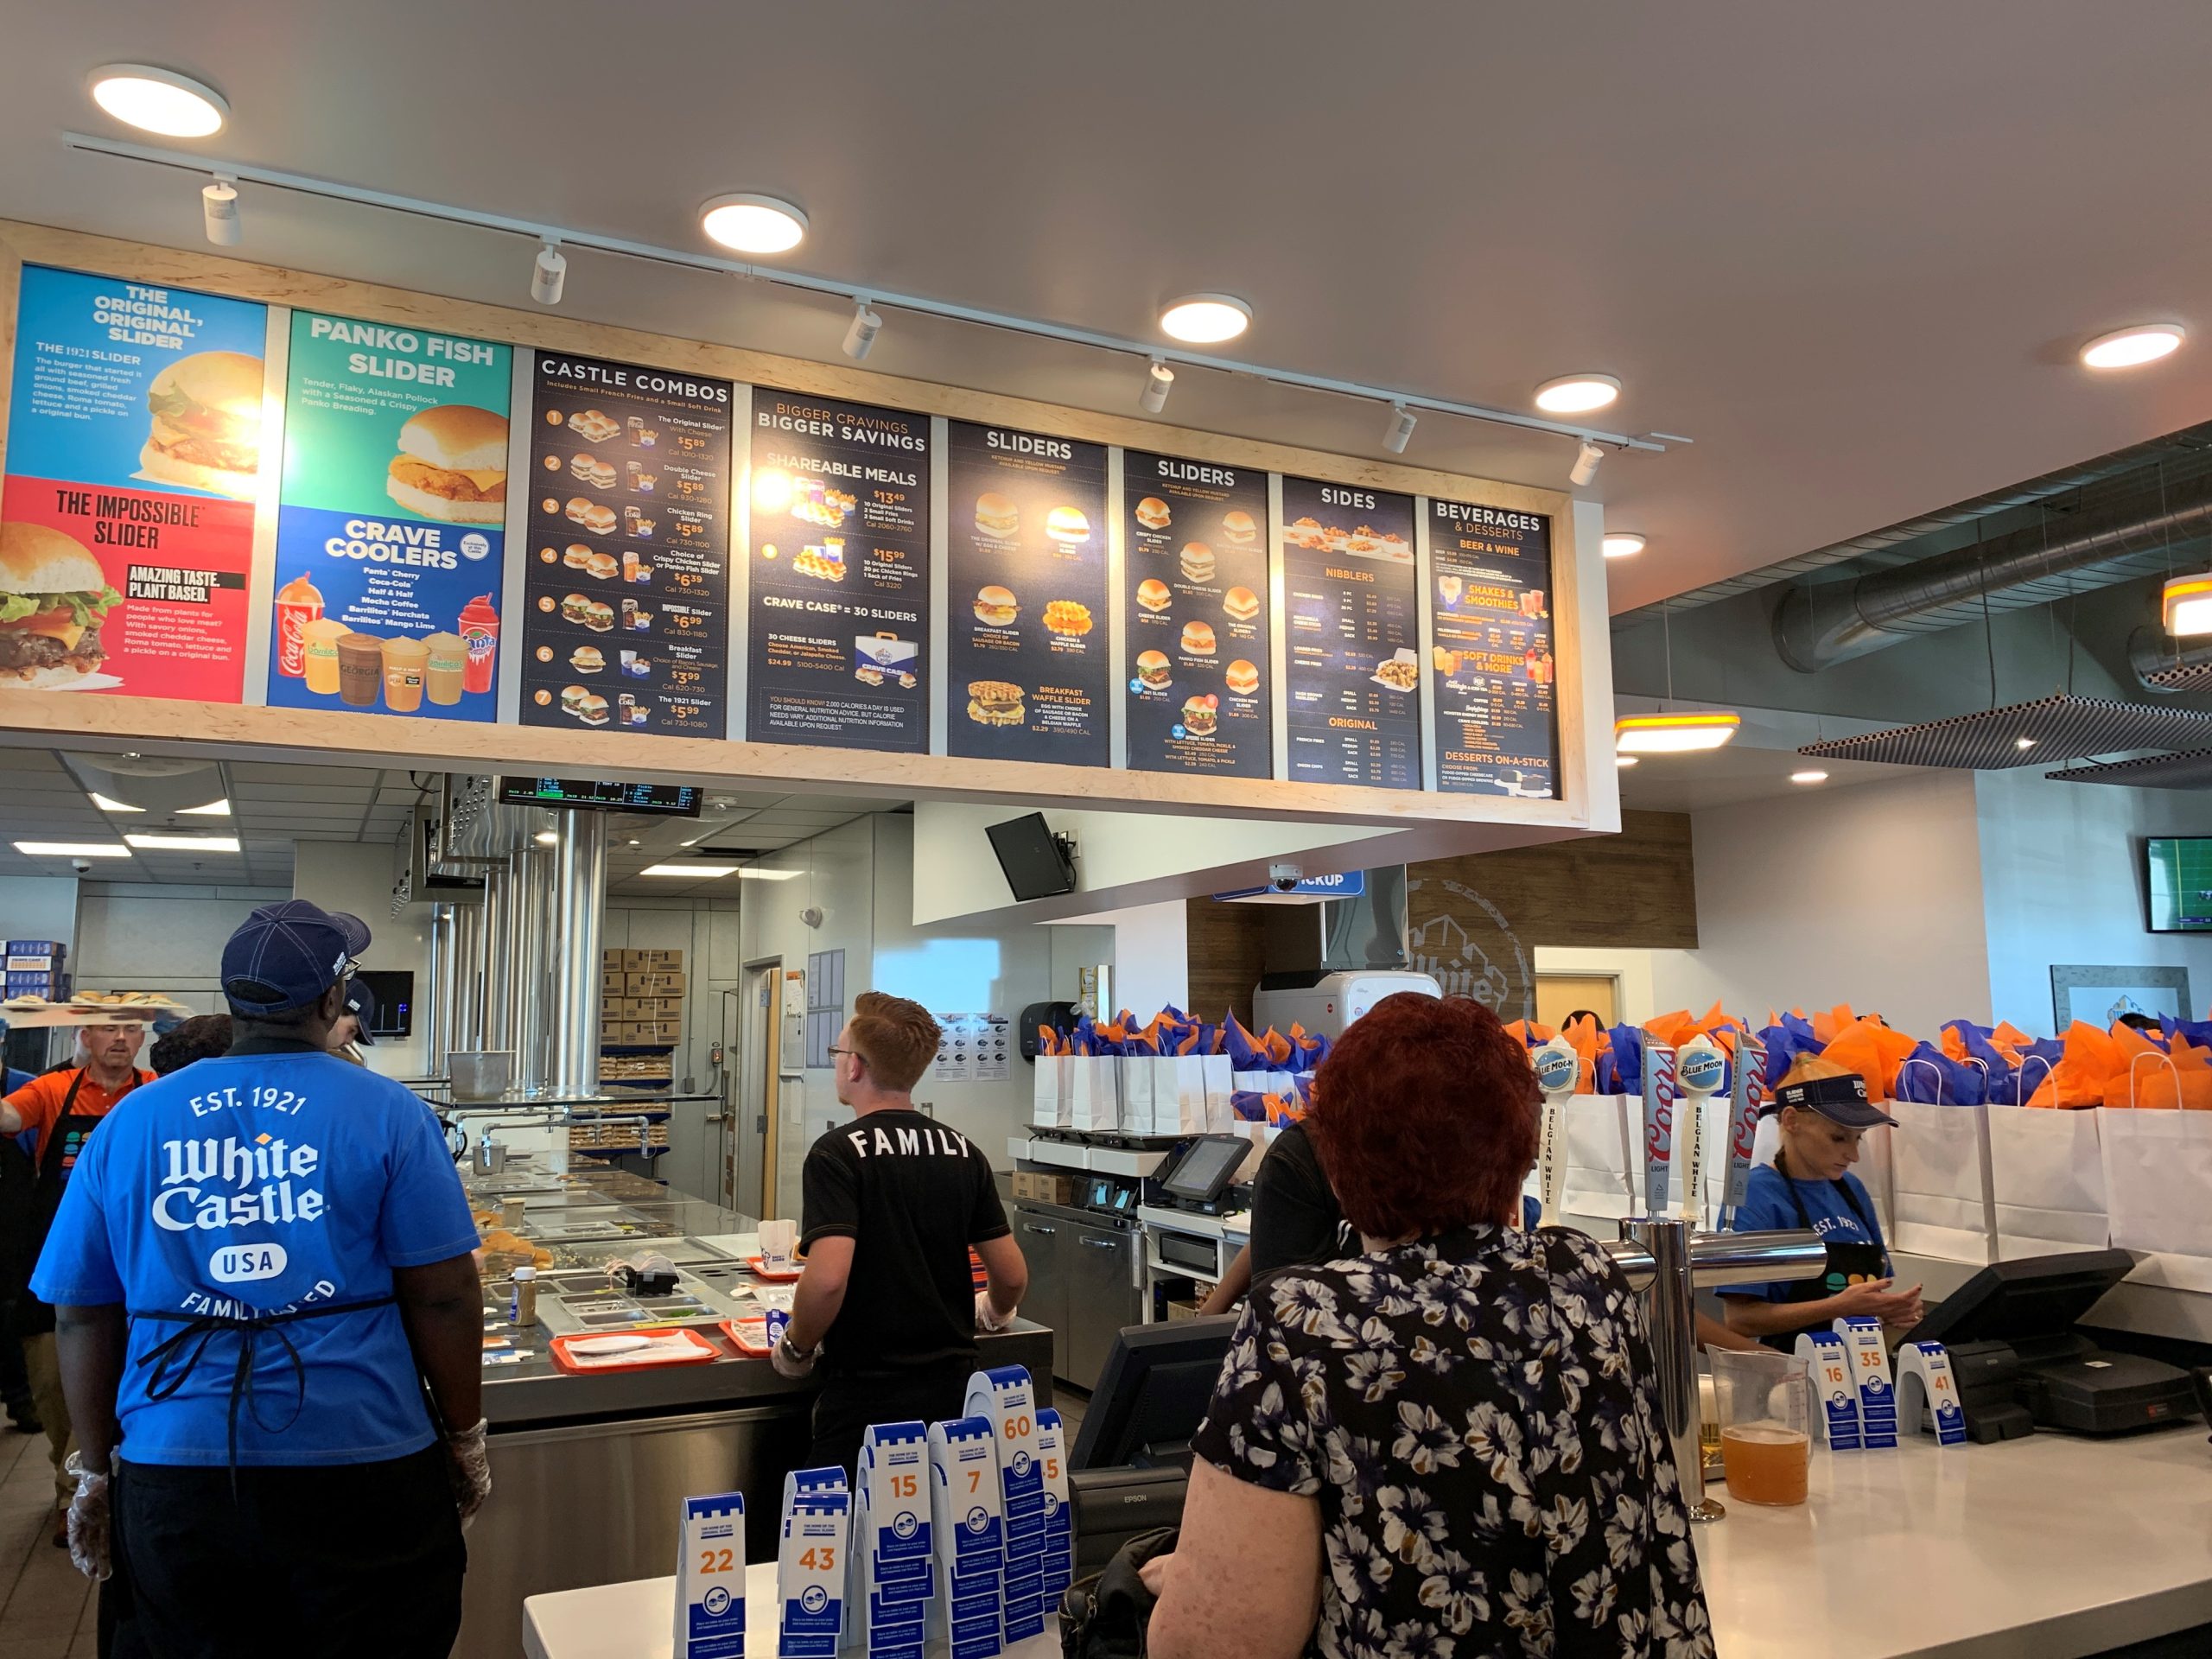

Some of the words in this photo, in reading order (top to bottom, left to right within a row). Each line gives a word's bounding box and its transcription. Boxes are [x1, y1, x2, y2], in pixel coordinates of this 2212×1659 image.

[126, 285, 168, 303] THE
[95, 296, 203, 327] ORIGINAL,
[93, 311, 194, 337] ORIGINAL
[109, 327, 183, 350] SLIDER
[311, 318, 418, 353] PANKO
[427, 337, 493, 366] FISH
[36, 342, 64, 354] THE
[66, 346, 90, 358] 1921
[92, 350, 141, 365] SLIDER
[54, 359, 83, 370] burger
[104, 365, 134, 376] started
[348, 353, 455, 387] SLIDER
[302, 378, 337, 390] Tender,
[339, 382, 365, 395] Flaky,
[368, 387, 403, 399] Alaskan
[405, 392, 438, 404] Pollock
[542, 359, 627, 386] CASTLE
[635, 375, 728, 403] COMBOS
[302, 387, 322, 397] with
[334, 392, 378, 405] Seasoned
[380, 397, 385, 406] &
[389, 400, 417, 411] Crispy
[547, 380, 576, 390] Includes
[579, 385, 599, 394] Small
[601, 389, 626, 398] French
[667, 399, 686, 408] Small
[302, 397, 330, 408] Panko
[334, 402, 377, 416] Breading.
[673, 417, 700, 429] Original
[777, 404, 830, 421] BIGGER
[836, 414, 908, 434] CRAVINGS
[759, 413, 834, 437] BIGGER
[842, 427, 925, 451] SAVINGS
[987, 431, 1072, 460] SLIDERS
[766, 453, 861, 479] SHAREABLE
[866, 467, 917, 486] MEALS
[1158, 461, 1235, 486] SLIDERS
[57, 490, 92, 515] THE
[96, 494, 200, 527] IMPOSSIBLE
[1321, 488, 1376, 509] SIDES
[1436, 502, 1540, 531] BEVERAGES
[95, 521, 159, 550] SLIDER
[346, 520, 441, 548] CRAVE
[1455, 522, 1462, 531] &
[1466, 523, 1522, 540] DESSERTS
[325, 537, 458, 569] COOLERS
[1459, 539, 1484, 551] BEER
[1496, 545, 1520, 556] WINE
[130, 566, 181, 584] AMAZING
[183, 570, 219, 588] TASTE.
[392, 569, 420, 580] Cherry
[1325, 568, 1374, 582] NIBBLERS
[130, 582, 166, 600] PLANT
[168, 586, 207, 602] BASED.
[361, 596, 389, 606] Mocha
[391, 600, 418, 608] Coffee
[368, 588, 385, 596] Half
[396, 589, 413, 598] Half
[1465, 596, 1518, 609] SMOOTHIES
[1469, 585, 1505, 598] SHAKES
[152, 607, 172, 615] from
[175, 608, 199, 619] plants
[392, 609, 429, 620] Horchata
[764, 596, 804, 610] CRAVE
[854, 607, 868, 617] 30
[871, 609, 917, 622] SLIDERS
[385, 619, 413, 629] Mango
[669, 645, 702, 653] Breakfast
[779, 634, 807, 643] CHEESE
[808, 638, 836, 646] SLIDERS
[1463, 651, 1487, 661] SOFT
[1490, 653, 1525, 665] DRINKS
[1476, 662, 1483, 671] &
[1484, 664, 1512, 673] MORE
[1032, 694, 1063, 702] WAFFLE
[1039, 686, 1083, 696] BREAKFAST
[1329, 718, 1377, 730] ORIGINAL
[1445, 752, 1493, 763] DESSERTS
[1496, 755, 1548, 767] ON-A-STICK
[1681, 1065, 1701, 1077] BLUE
[1703, 1060, 1723, 1071] MOON
[190, 1087, 242, 1116] EST.
[252, 1087, 307, 1116] 1921
[1648, 1050, 1675, 1162] Coors
[1732, 1050, 1769, 1160] Coors
[848, 1128, 969, 1158] FAMILY
[1546, 1109, 1555, 1161] BELGIAN
[1694, 1107, 1702, 1157] BELGIAN
[161, 1132, 318, 1190] White
[1692, 1161, 1700, 1197] WHITE
[152, 1180, 323, 1230] Castle
[223, 1251, 273, 1274] USA
[1860, 1351, 1881, 1367] 35
[1826, 1367, 1843, 1382] 16
[1936, 1376, 1949, 1390] 41
[1005, 1415, 1031, 1440] 60
[1042, 1459, 1058, 1479] 5
[890, 1475, 917, 1498] 15
[968, 1471, 981, 1493] 7
[1124, 1495, 1147, 1503] EPSON
[700, 1548, 733, 1574] 22
[799, 1548, 835, 1571] 43
